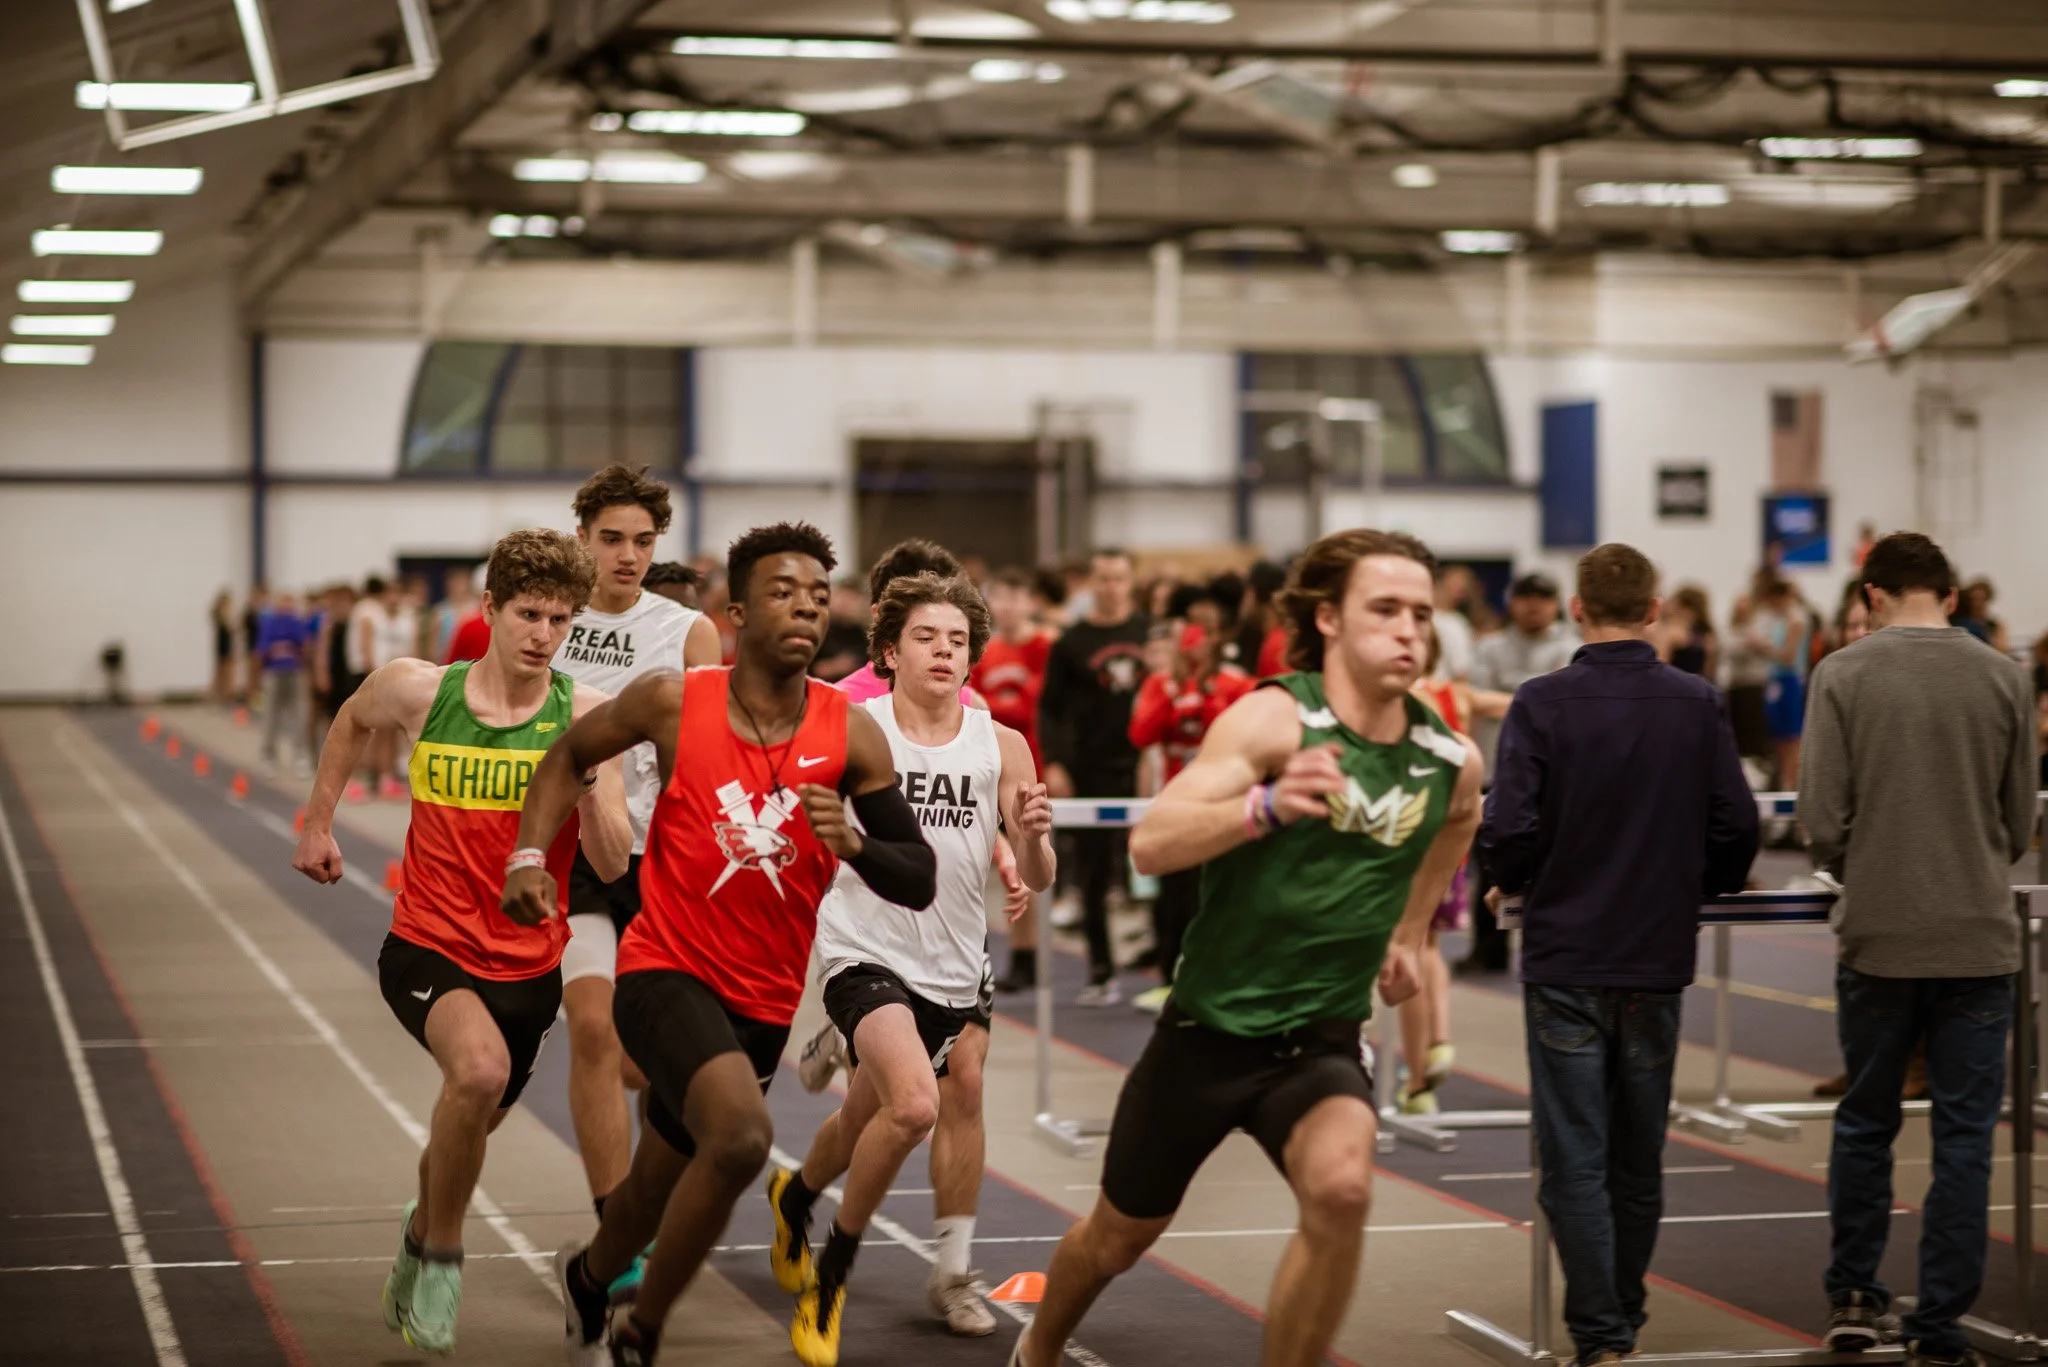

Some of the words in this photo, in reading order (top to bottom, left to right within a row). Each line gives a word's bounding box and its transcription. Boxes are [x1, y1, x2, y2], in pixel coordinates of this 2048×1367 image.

[568, 626, 635, 652] REAL
[564, 645, 635, 668] TRAINING
[428, 753, 541, 802] ETHIOP
[916, 806, 974, 829] INING
